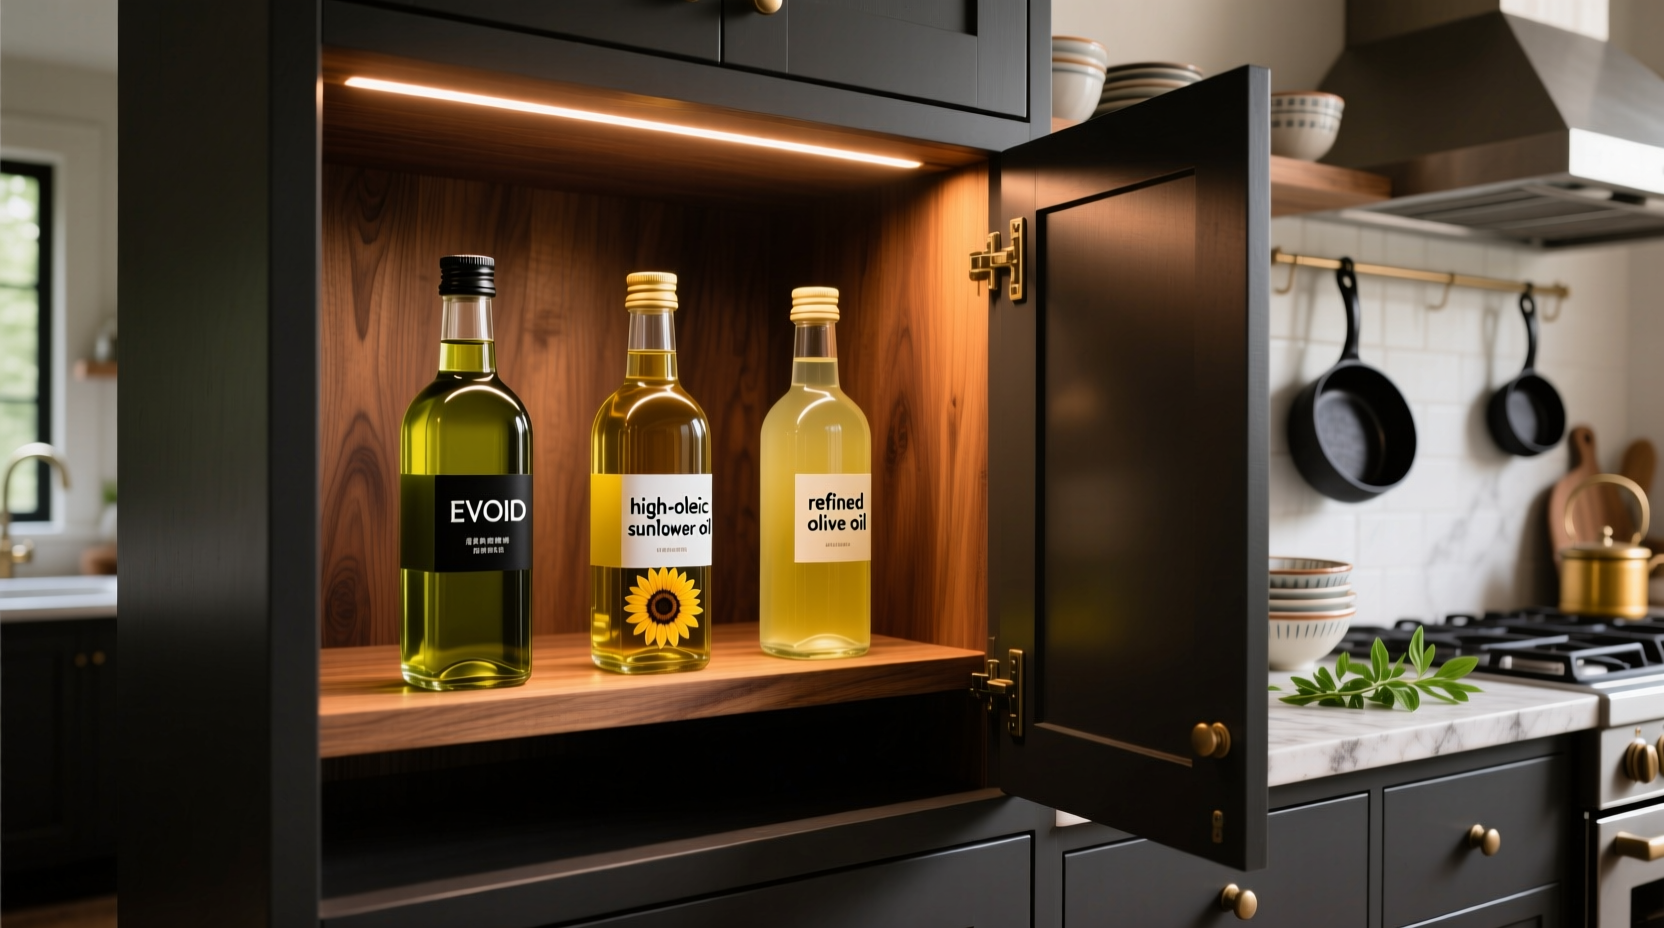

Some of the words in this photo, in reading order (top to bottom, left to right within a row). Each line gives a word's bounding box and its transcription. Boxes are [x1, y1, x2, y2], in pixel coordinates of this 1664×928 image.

[450, 499, 527, 523] EVOID
[630, 495, 709, 520] high-oleic
[808, 492, 864, 511] refined
[807, 513, 847, 532] olive
[849, 512, 867, 531] oil
